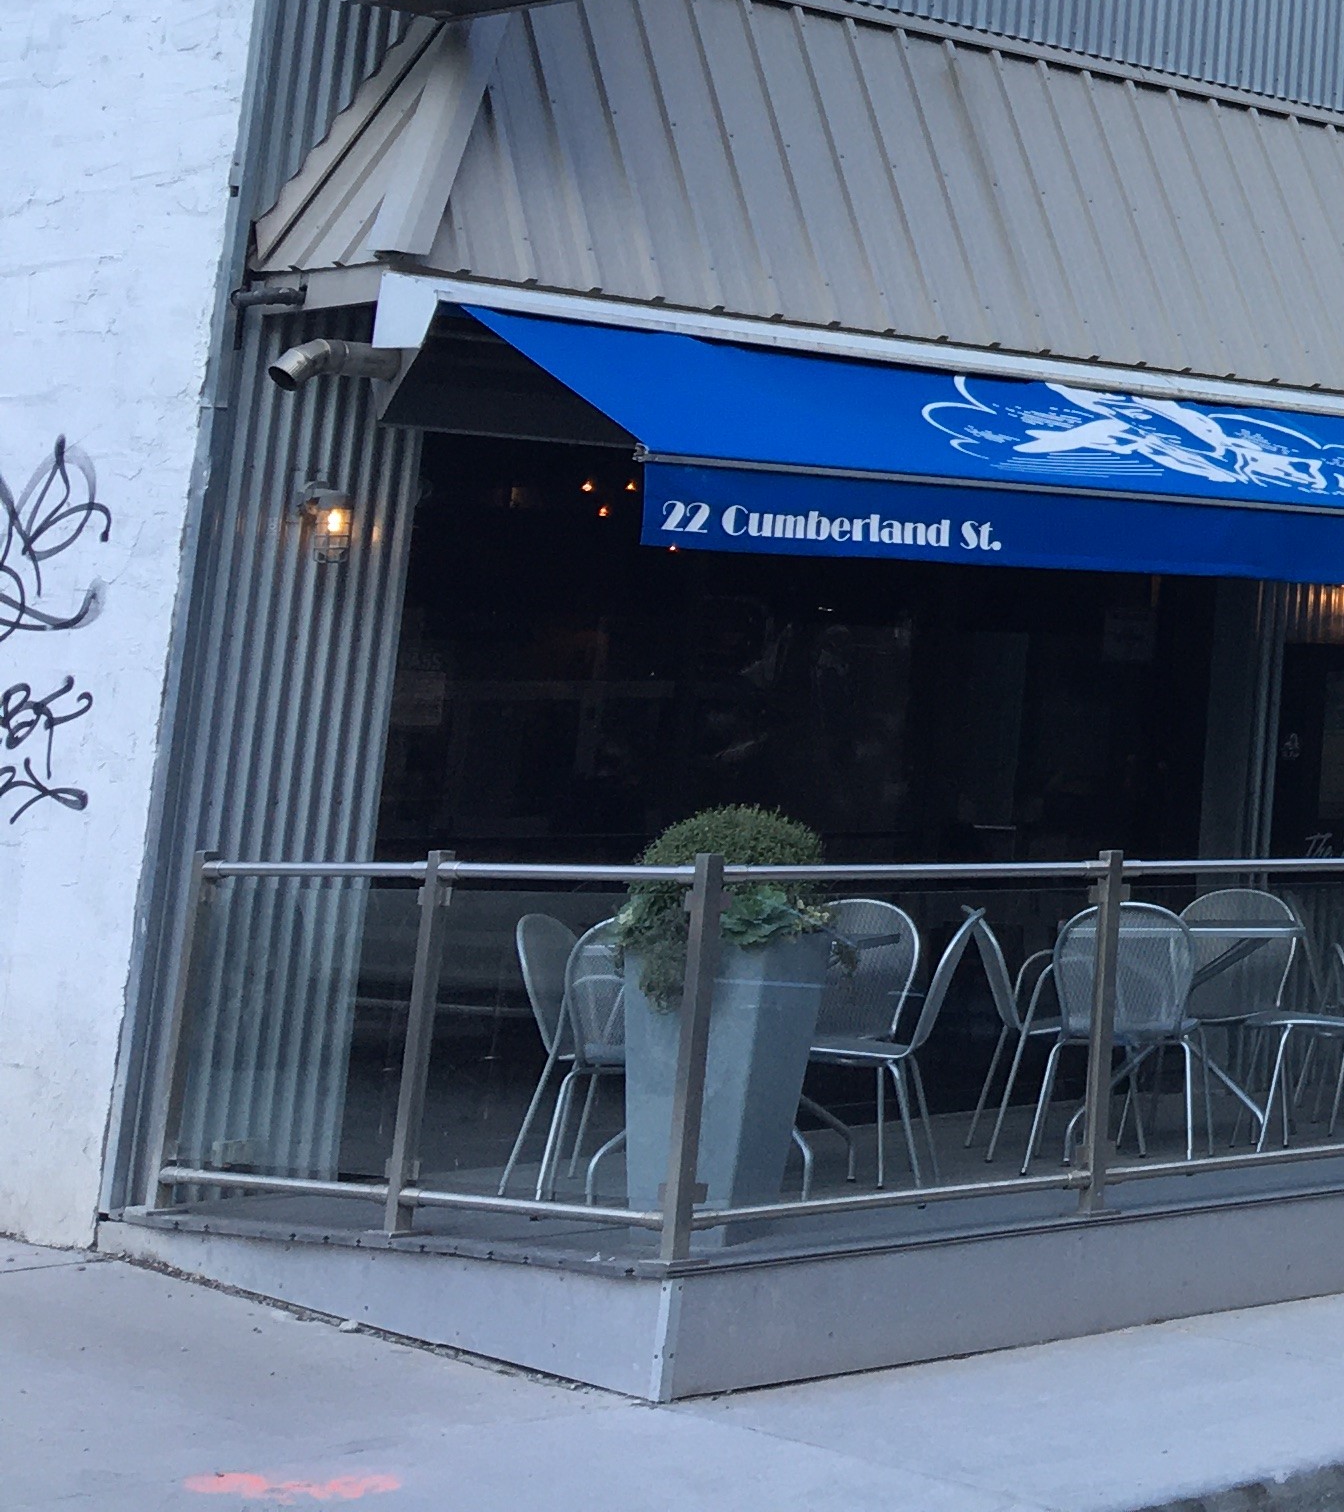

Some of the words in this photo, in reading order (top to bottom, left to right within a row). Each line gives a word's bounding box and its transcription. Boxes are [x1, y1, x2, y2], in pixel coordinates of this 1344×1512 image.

[660, 500, 709, 536] 22
[722, 504, 950, 550] Cumberland
[960, 519, 1002, 552] St.
